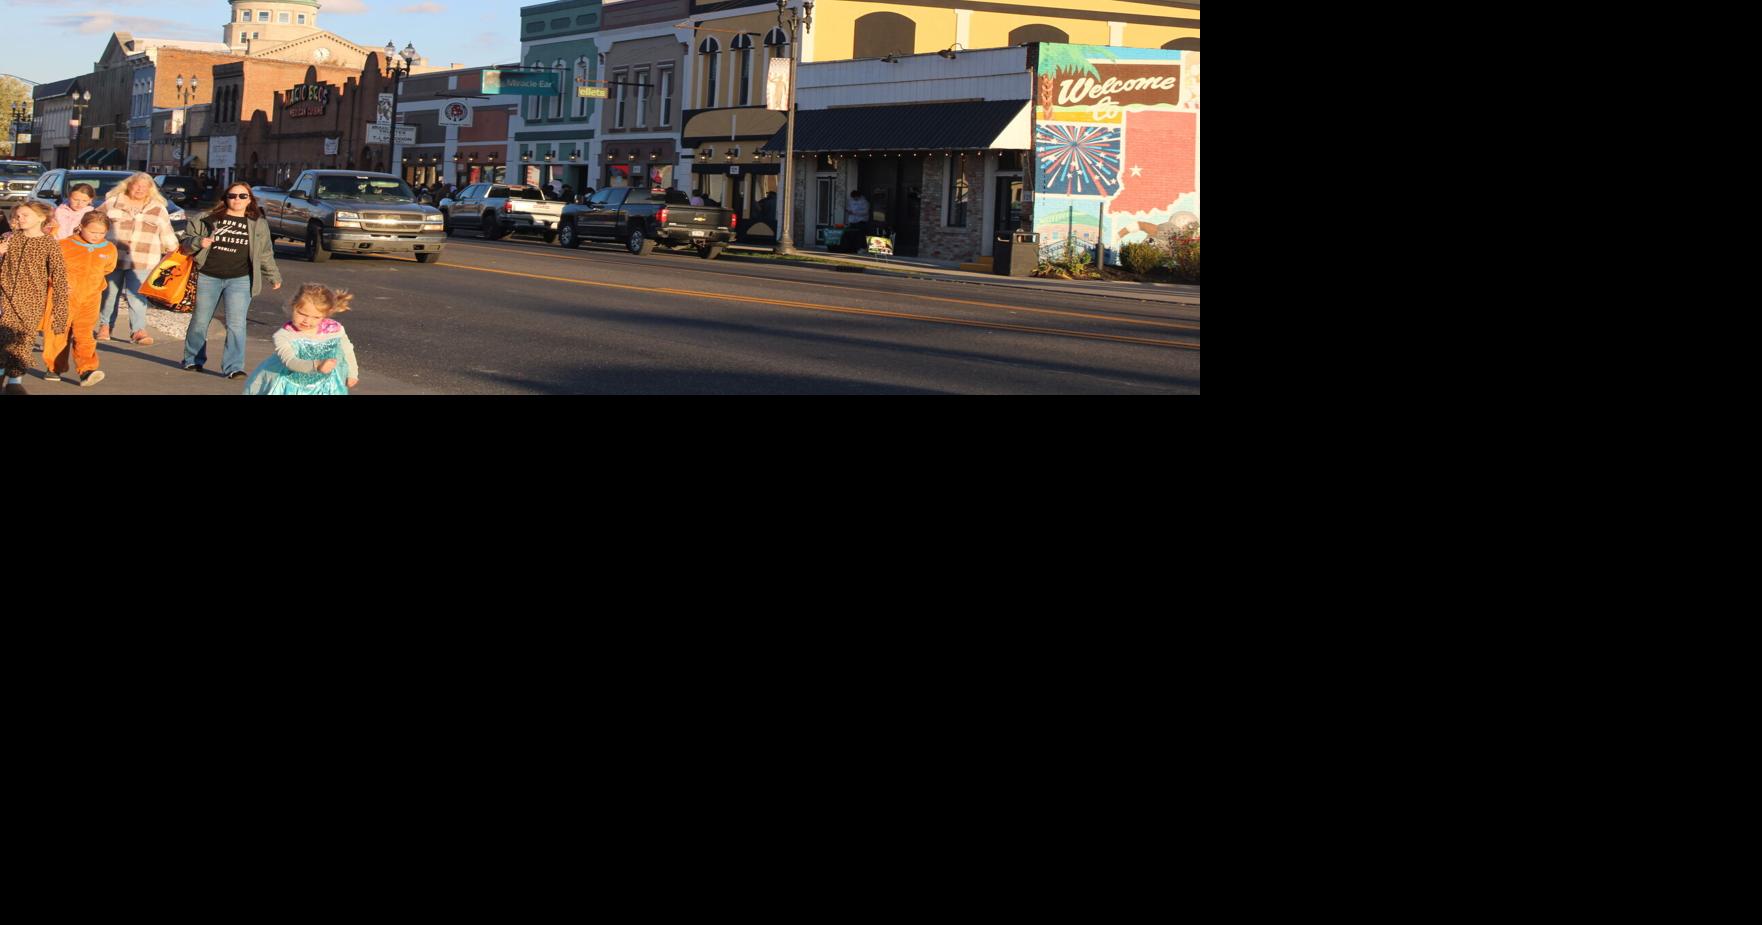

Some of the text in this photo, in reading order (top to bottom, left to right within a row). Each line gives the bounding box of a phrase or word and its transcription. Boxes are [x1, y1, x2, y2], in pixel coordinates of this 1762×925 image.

[507, 79, 552, 88] Miracle Ear
[1058, 75, 1176, 106] Welcome
[1087, 96, 1119, 121] to
[222, 219, 237, 227] RUN
[237, 222, 248, 230] ON
[222, 236, 249, 246] KISSES
